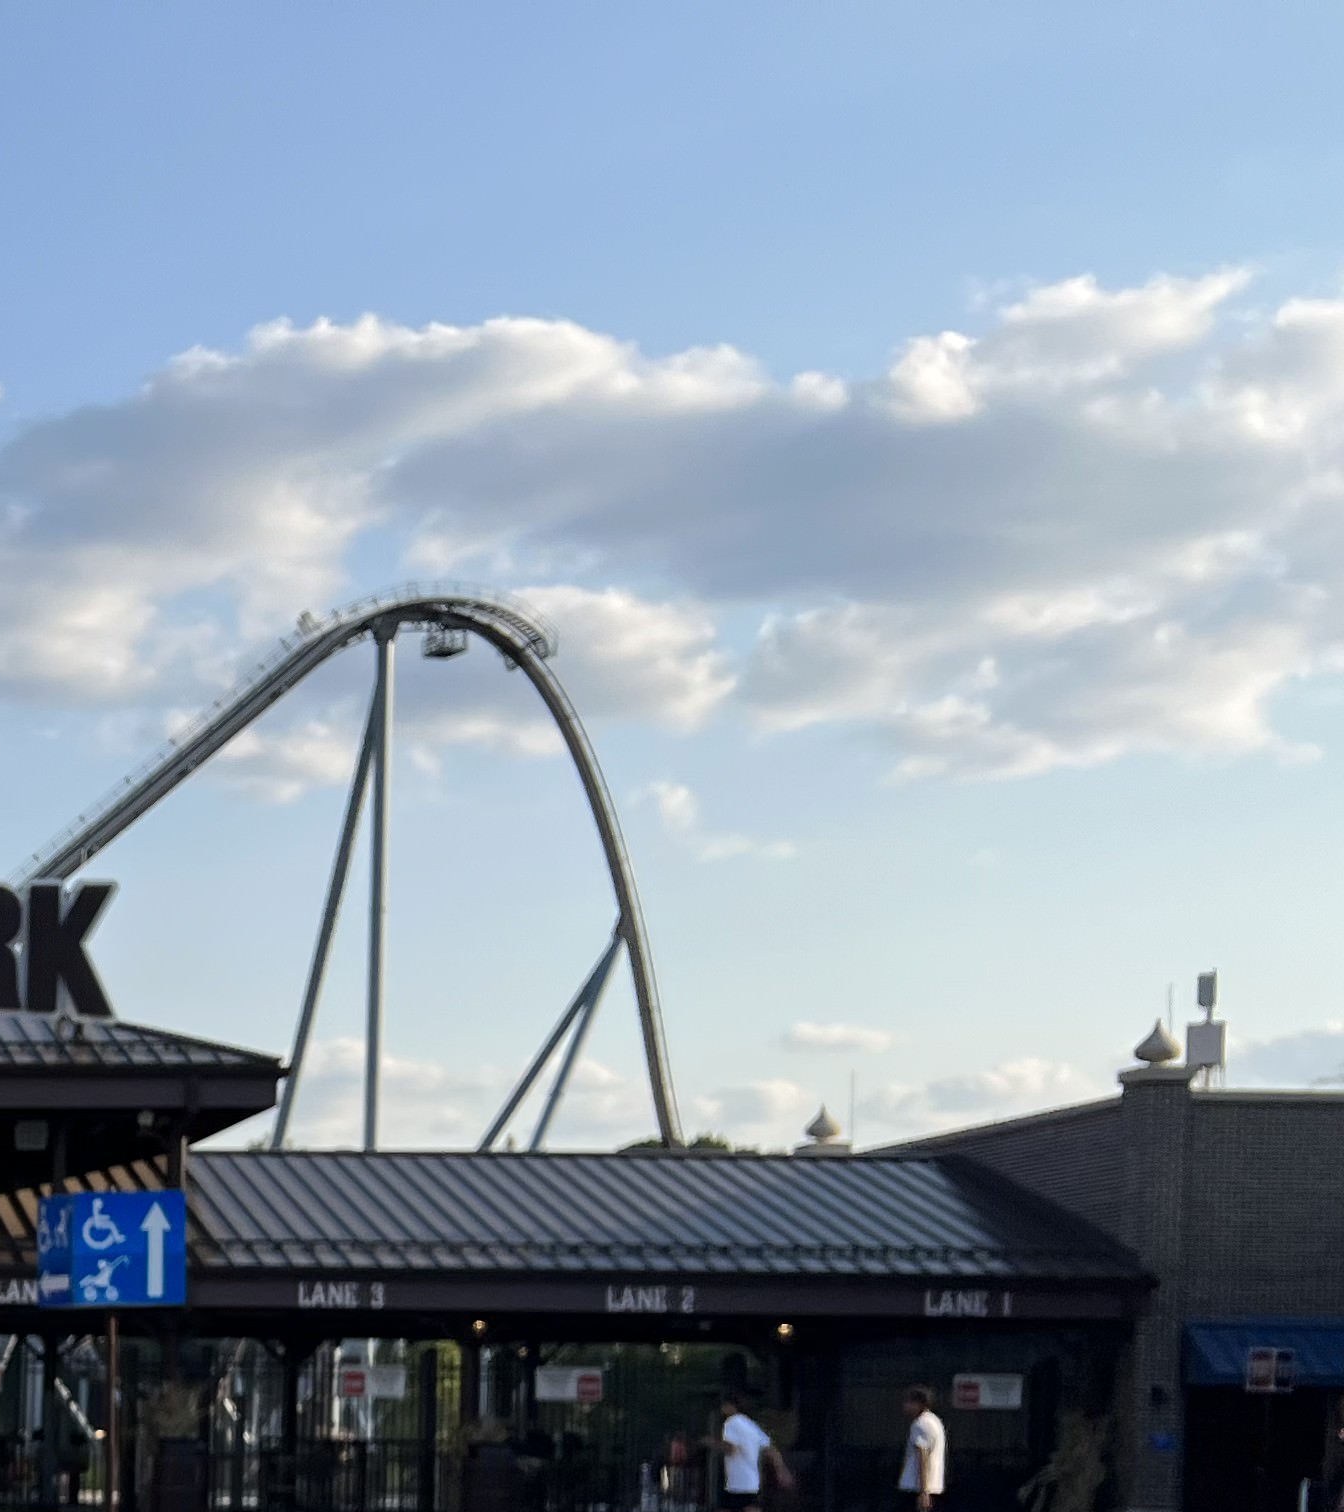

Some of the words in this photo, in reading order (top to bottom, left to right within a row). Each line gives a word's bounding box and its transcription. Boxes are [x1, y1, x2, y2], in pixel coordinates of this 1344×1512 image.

[297, 1281, 359, 1308] LANE
[370, 1281, 384, 1309] 3
[607, 1285, 667, 1313] LANE
[681, 1285, 694, 1313] 2
[924, 1289, 988, 1318] LANE
[1003, 1291, 1011, 1317] 1
